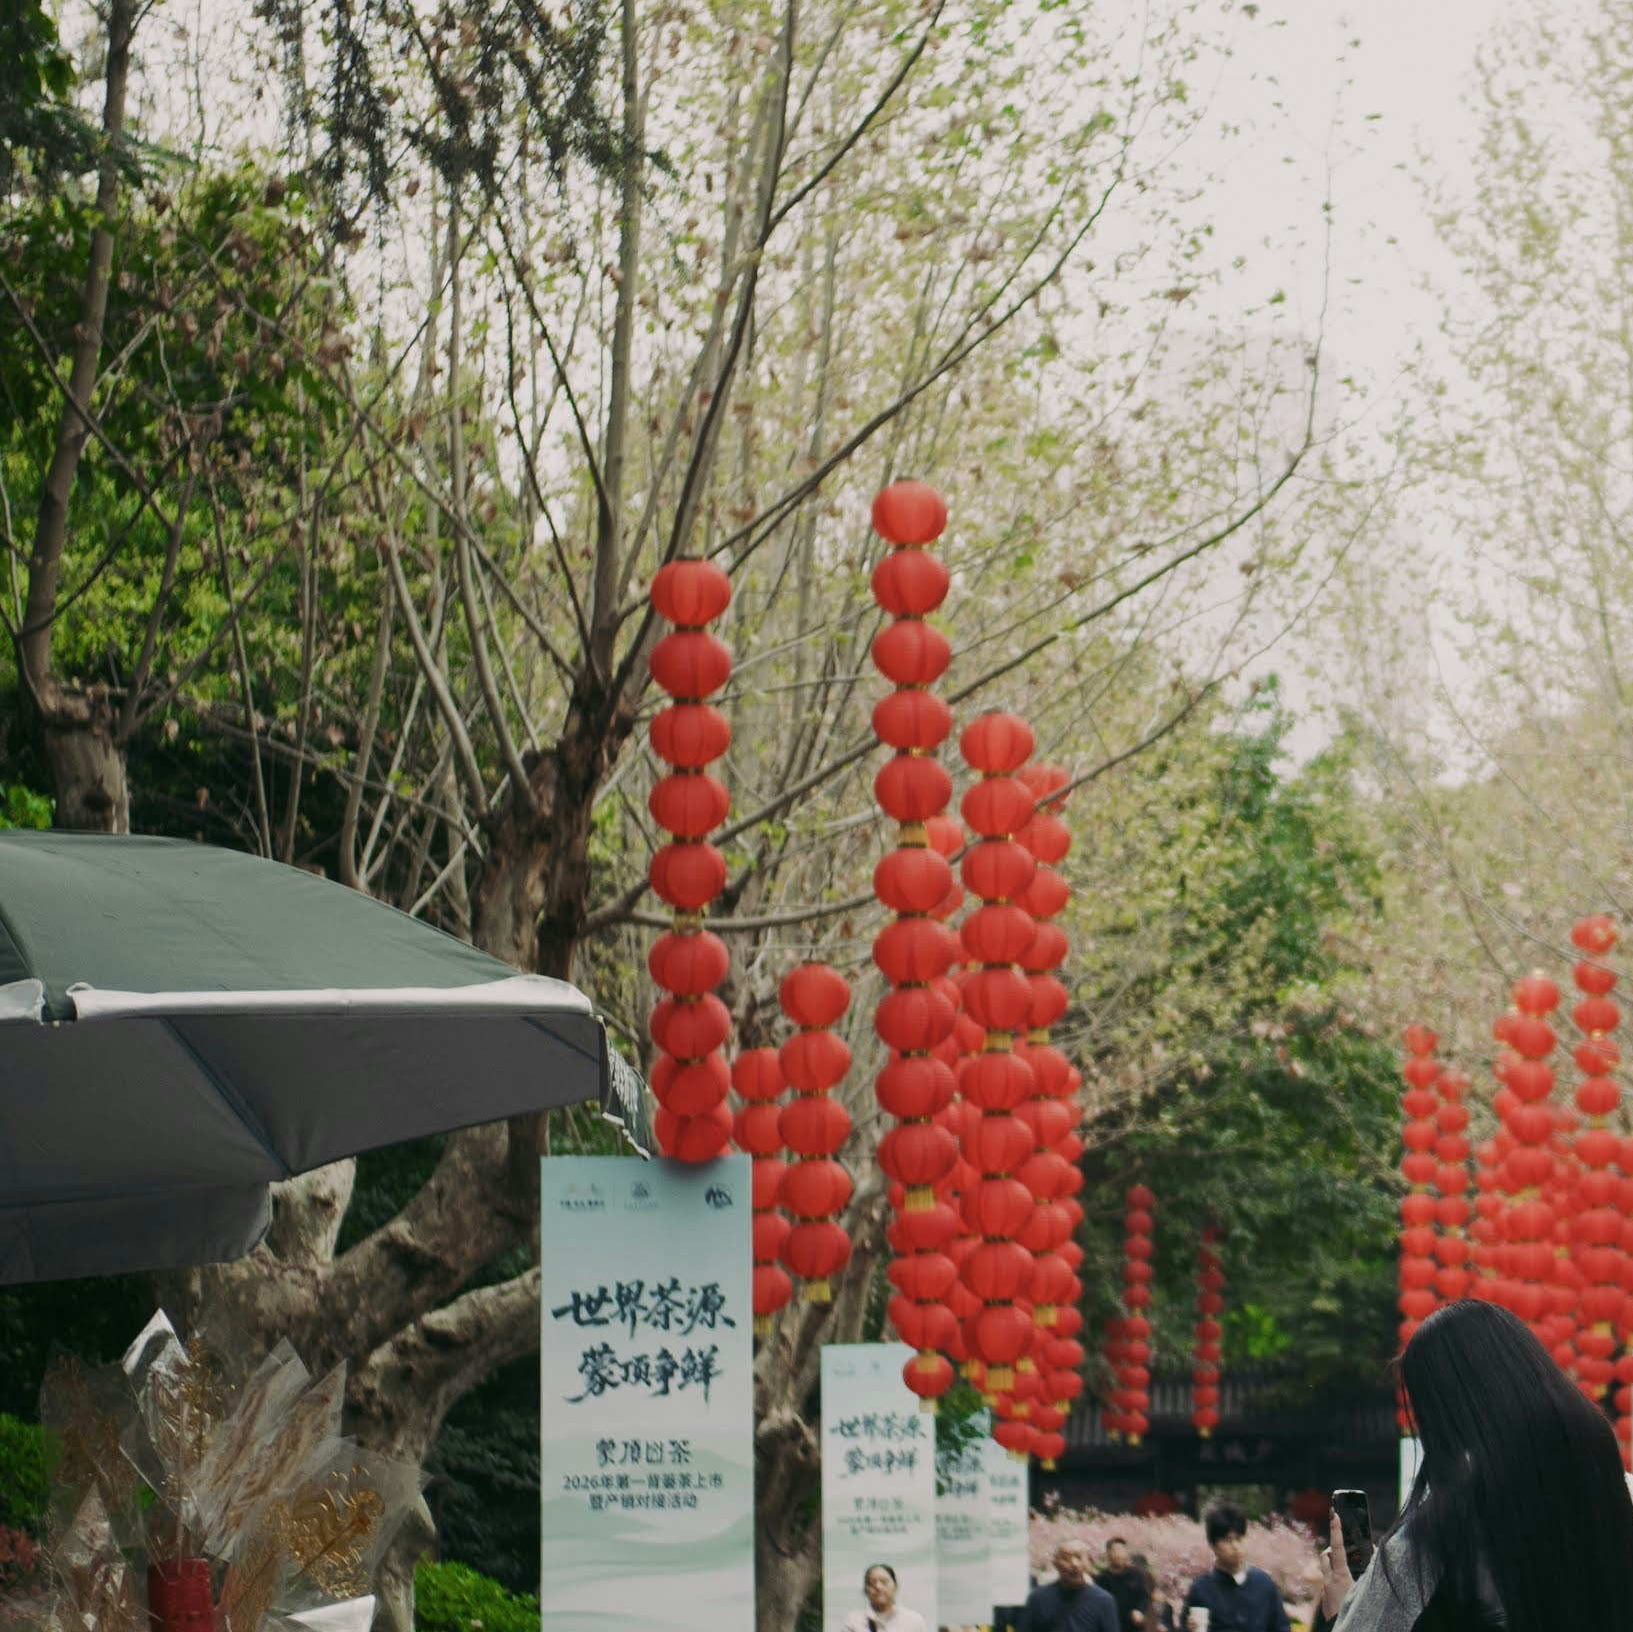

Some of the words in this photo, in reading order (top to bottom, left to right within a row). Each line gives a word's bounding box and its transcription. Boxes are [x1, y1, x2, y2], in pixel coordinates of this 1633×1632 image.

[551, 1276, 736, 1340] 世界茶源
[561, 1341, 723, 1404] 蒙顶争鲜
